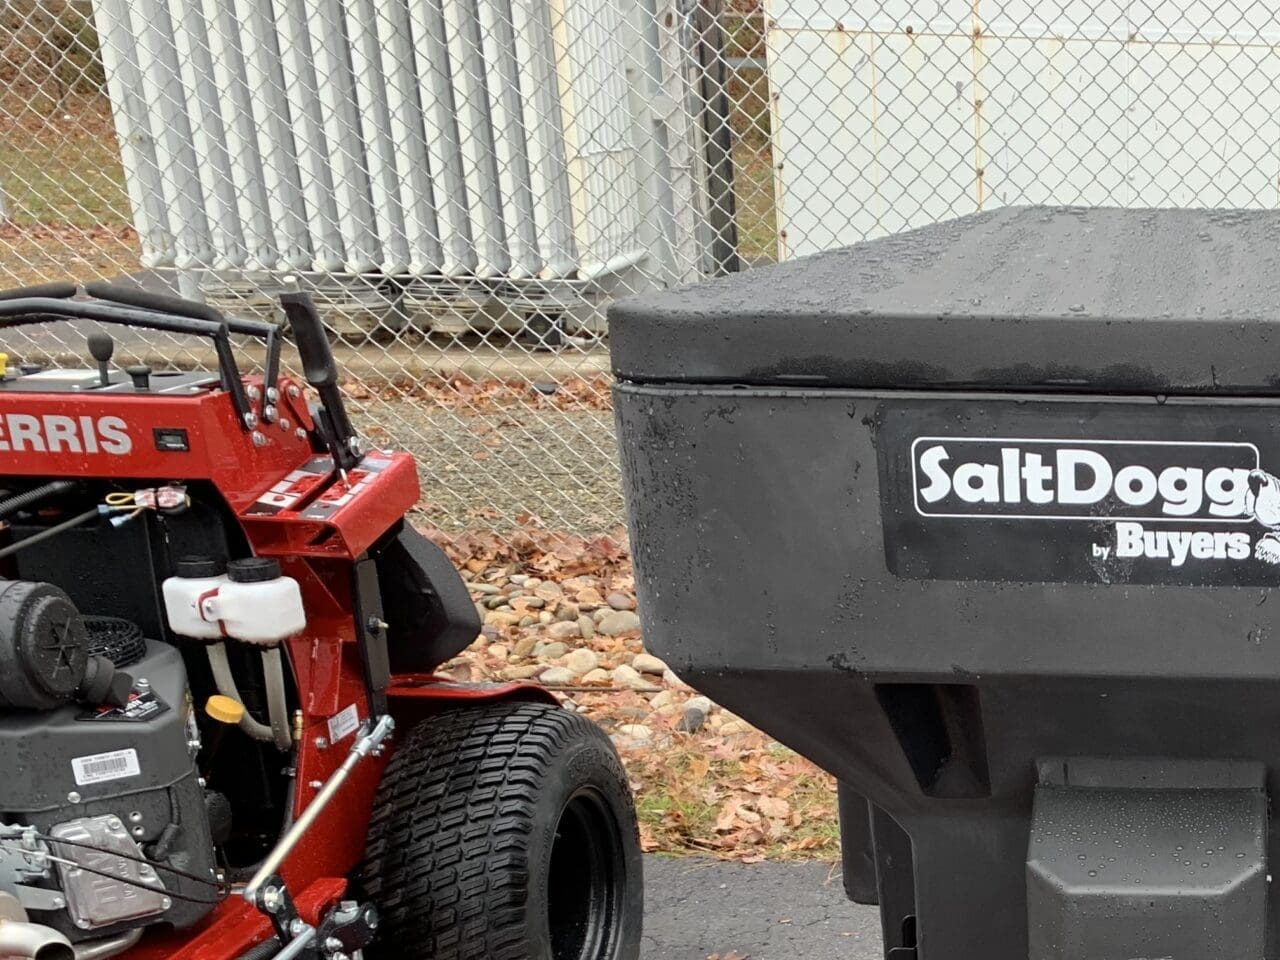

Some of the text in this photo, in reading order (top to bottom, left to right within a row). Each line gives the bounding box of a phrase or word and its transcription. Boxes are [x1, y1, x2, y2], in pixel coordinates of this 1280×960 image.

[919, 444, 1251, 517] SaltDogg
[1092, 522, 1251, 567] by Buyers
